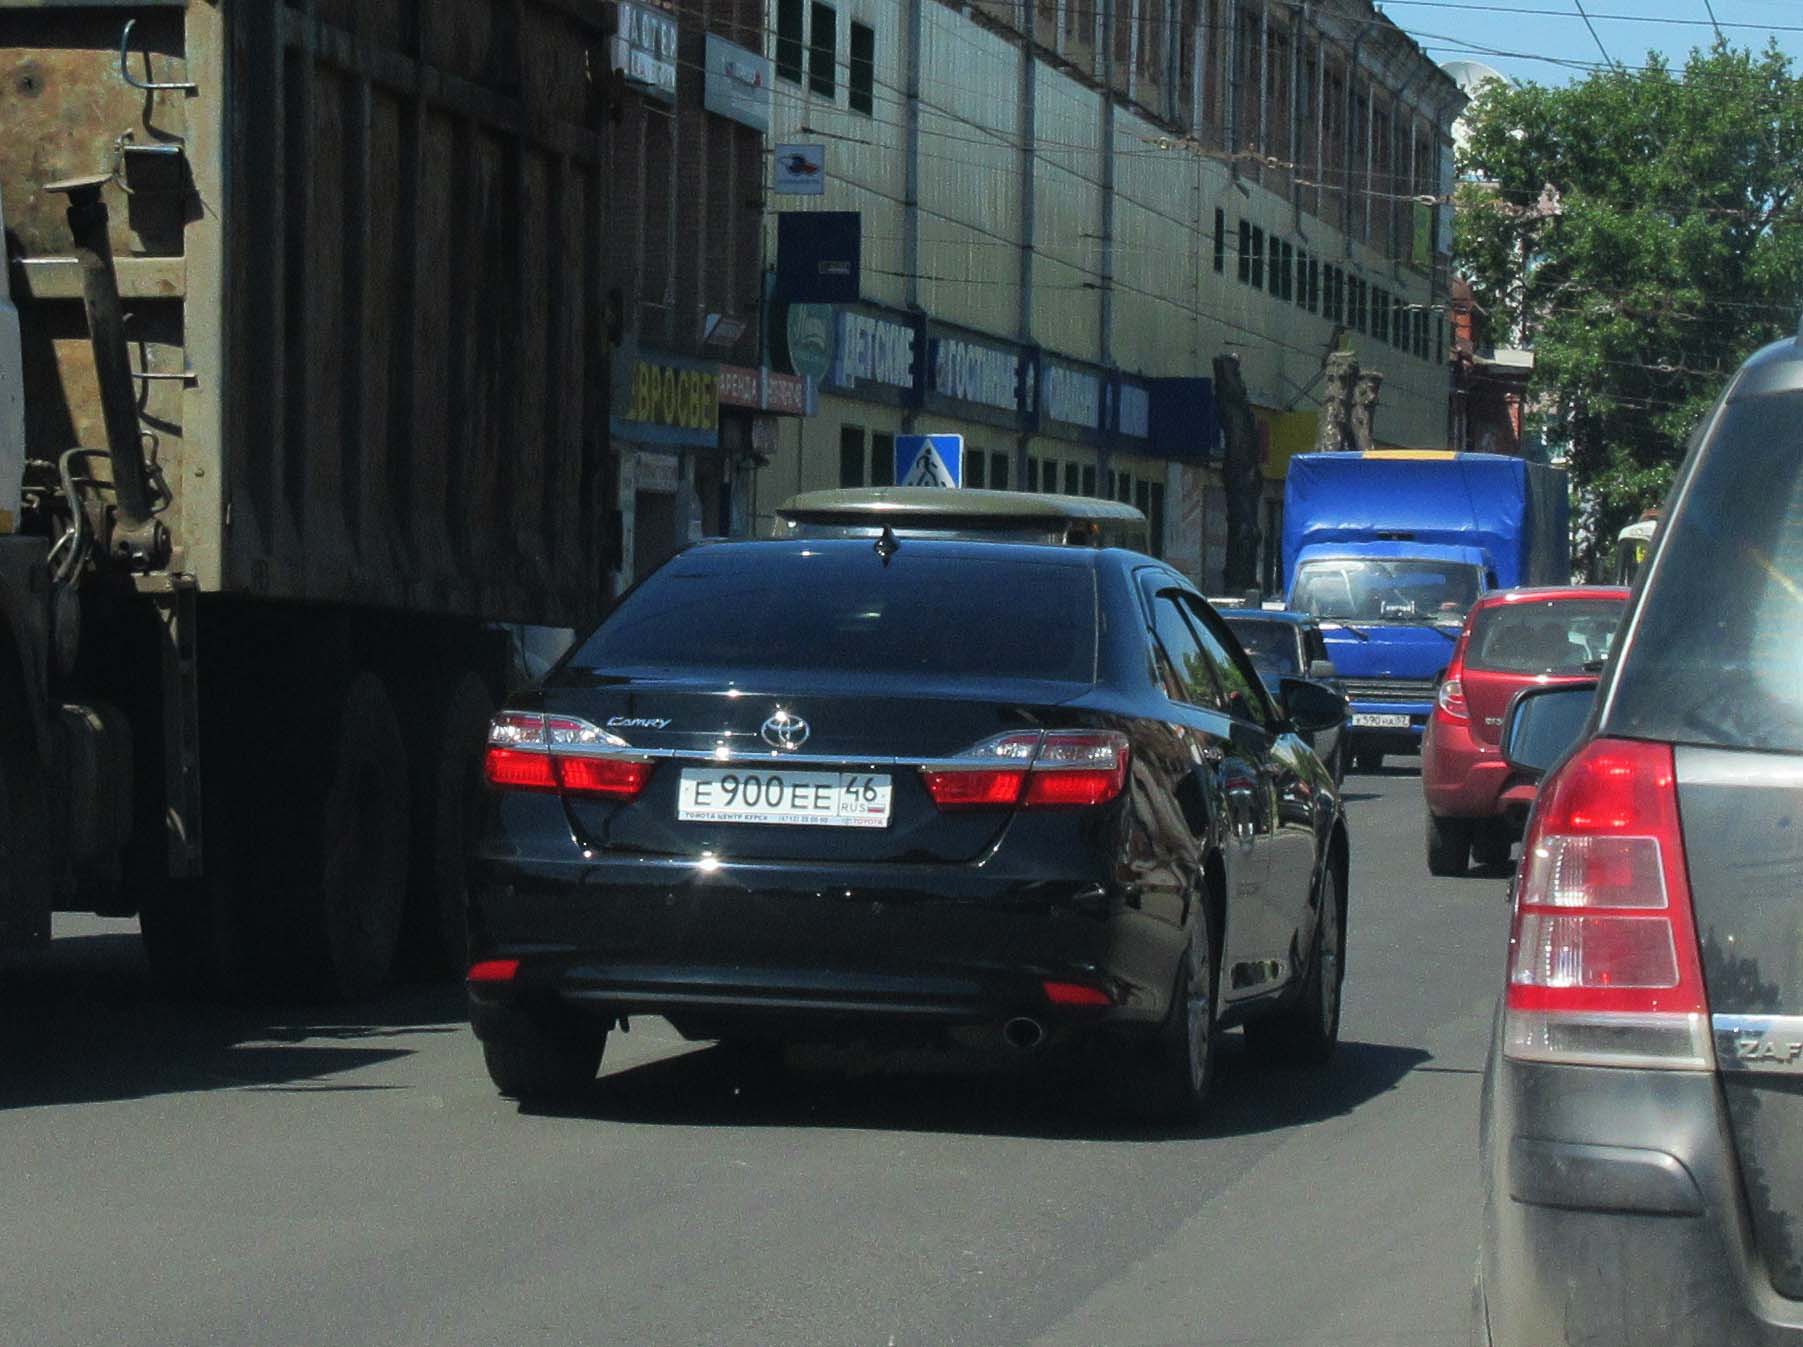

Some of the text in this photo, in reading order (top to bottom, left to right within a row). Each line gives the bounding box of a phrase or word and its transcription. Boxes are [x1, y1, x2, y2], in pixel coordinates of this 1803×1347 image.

[845, 776, 878, 802] 46
[841, 803, 866, 813] RUS
[853, 817, 884, 827] TOYOTA
